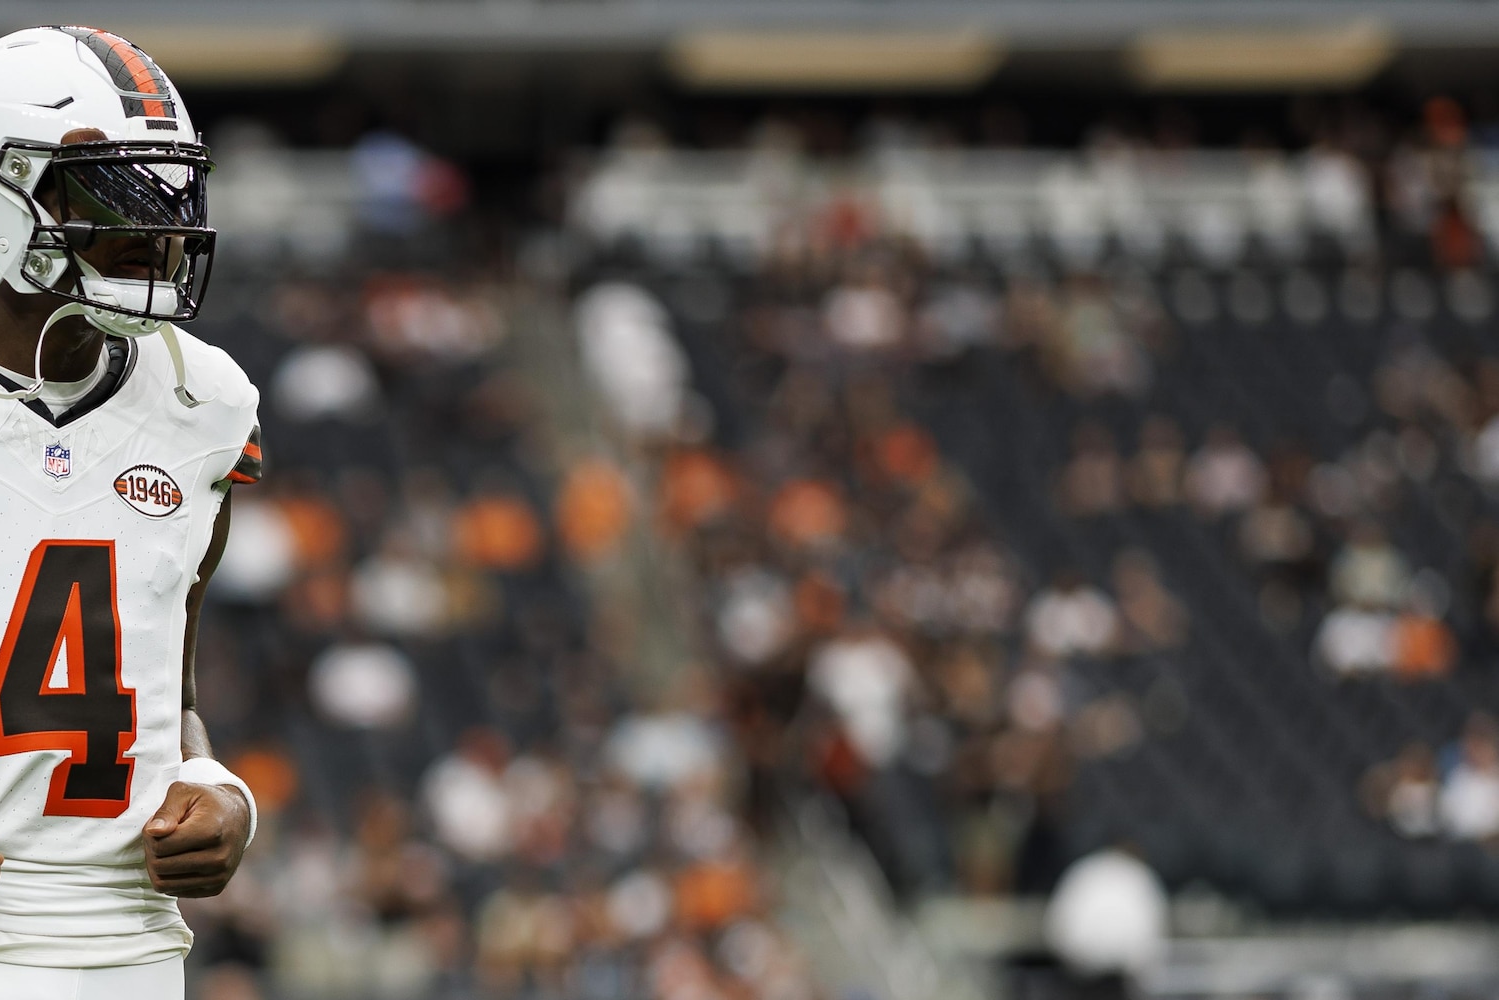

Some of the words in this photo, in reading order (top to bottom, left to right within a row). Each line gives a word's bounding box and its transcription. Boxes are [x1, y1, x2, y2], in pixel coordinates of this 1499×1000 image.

[145, 120, 179, 131] BROWNS
[47, 457, 68, 473] NFL
[128, 475, 171, 508] 1946
